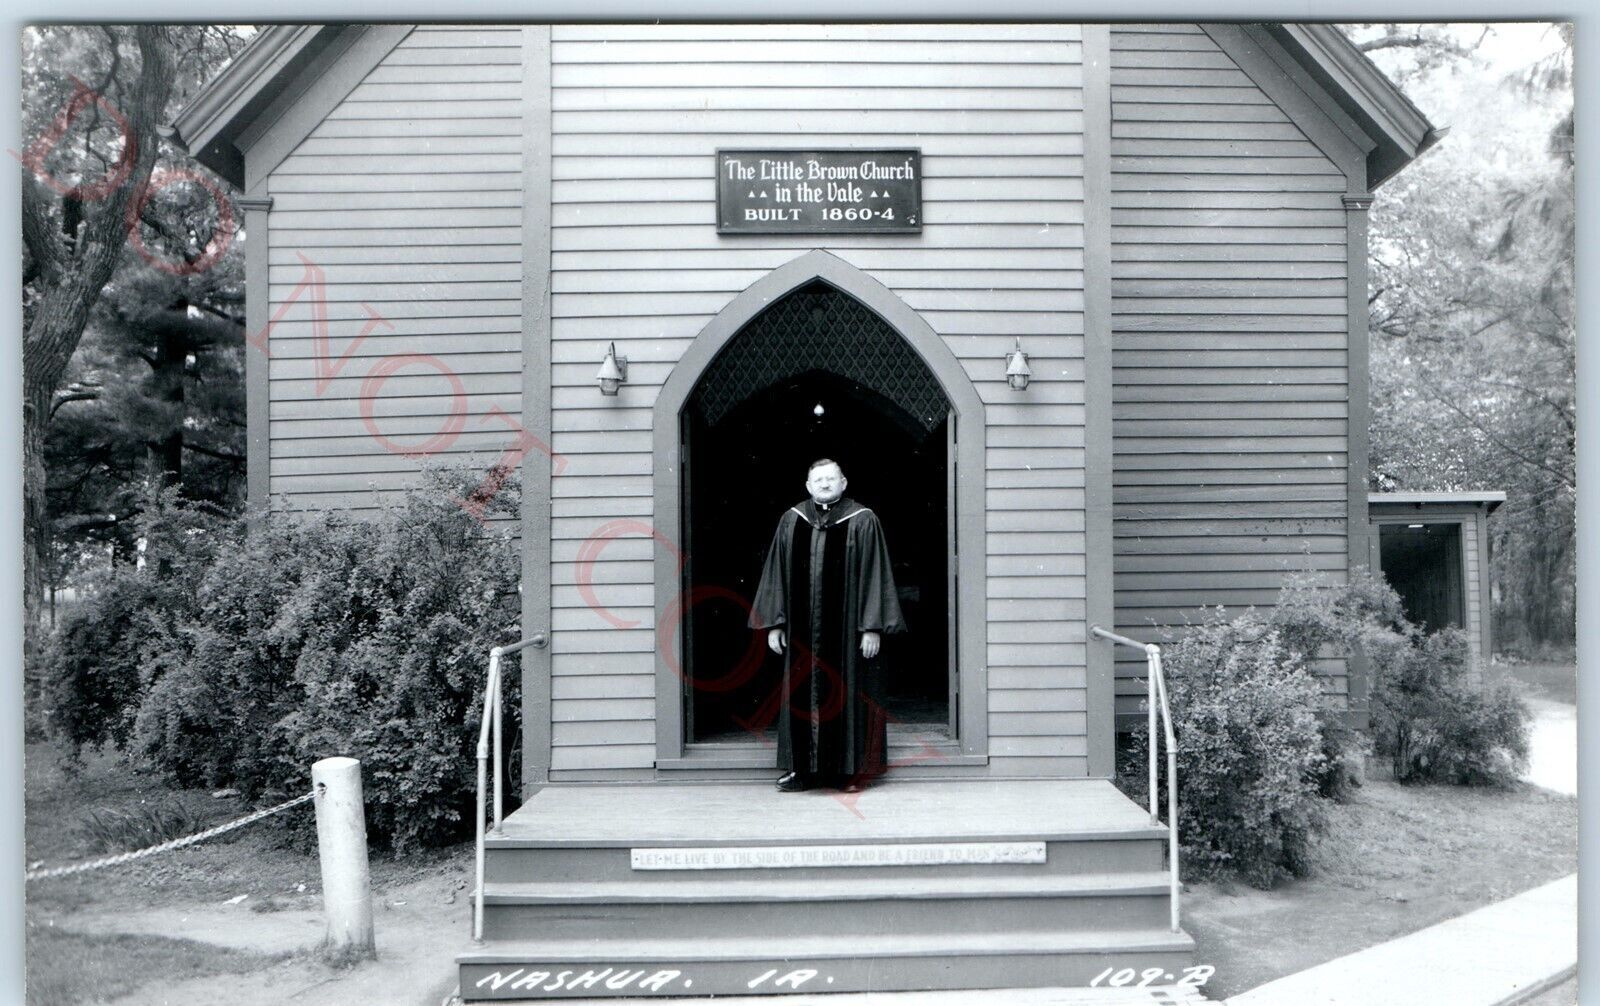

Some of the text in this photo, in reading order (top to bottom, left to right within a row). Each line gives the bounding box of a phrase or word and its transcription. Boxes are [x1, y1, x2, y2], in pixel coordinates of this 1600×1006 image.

[725, 159, 915, 180] The Little Brown Church
[775, 182, 863, 203] in the Vale
[744, 208, 895, 221] BUILT 1860-4
[664, 853, 681, 866] ME
[685, 852, 709, 865] LIVE
[713, 852, 726, 865] BY
[731, 852, 753, 865] THE
[755, 851, 780, 865] SIDE
[782, 851, 797, 864] OF
[799, 851, 819, 863] THE
[822, 850, 850, 863] ROAD
[853, 850, 876, 863] AND
[894, 849, 904, 862] A
[949, 848, 963, 861] TO
